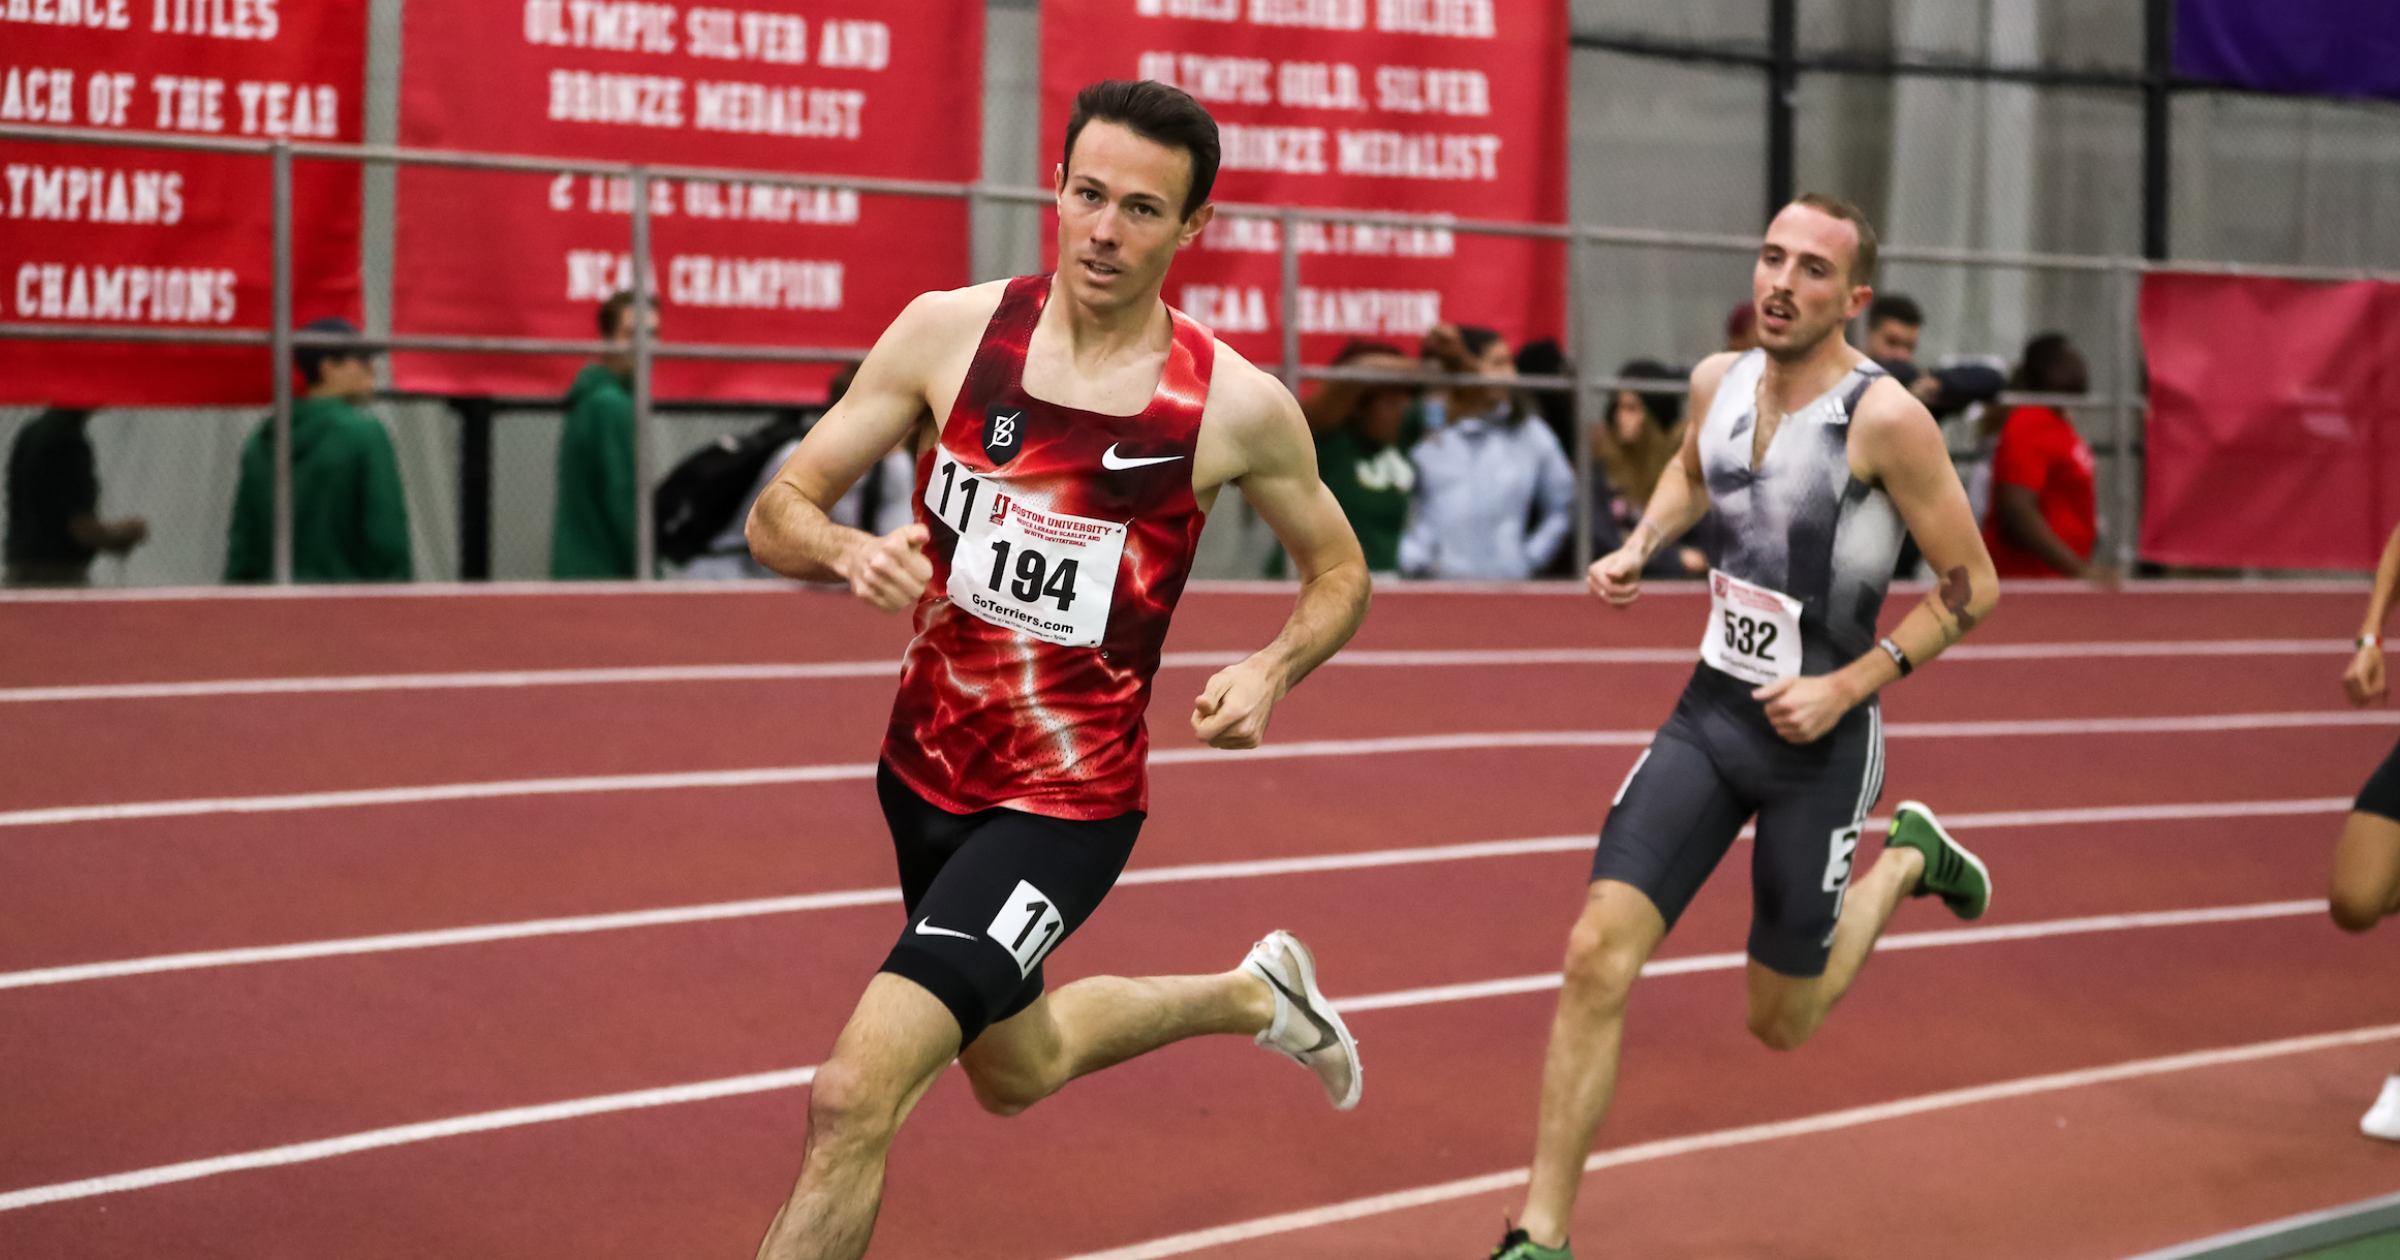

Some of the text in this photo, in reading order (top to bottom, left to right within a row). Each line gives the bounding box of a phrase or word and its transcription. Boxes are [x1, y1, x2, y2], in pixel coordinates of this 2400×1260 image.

[524, 0, 891, 72] OLYMPIC SILVER AND
[88, 70, 136, 127] OF
[152, 74, 225, 132] THE
[236, 80, 340, 138] YEAR
[548, 69, 866, 140] BRONZE MEDALIST
[1374, 64, 1491, 116] SILVER
[1216, 123, 1501, 181] RONZE MEDALIST
[0, 163, 184, 226] YMPIANS
[16, 262, 237, 324] CHAMPIONS
[667, 254, 845, 310] CHAMPION
[1296, 285, 1443, 337] HAMPION
[939, 461, 980, 534] 11
[1011, 503, 1112, 536] BOSTON UNIVERSITY
[1024, 528, 1044, 540] WHITE
[988, 540, 1079, 611] 194
[972, 594, 1074, 634] GoTerriers.com
[1724, 609, 1778, 661] 532
[1012, 901, 1060, 969] 11
